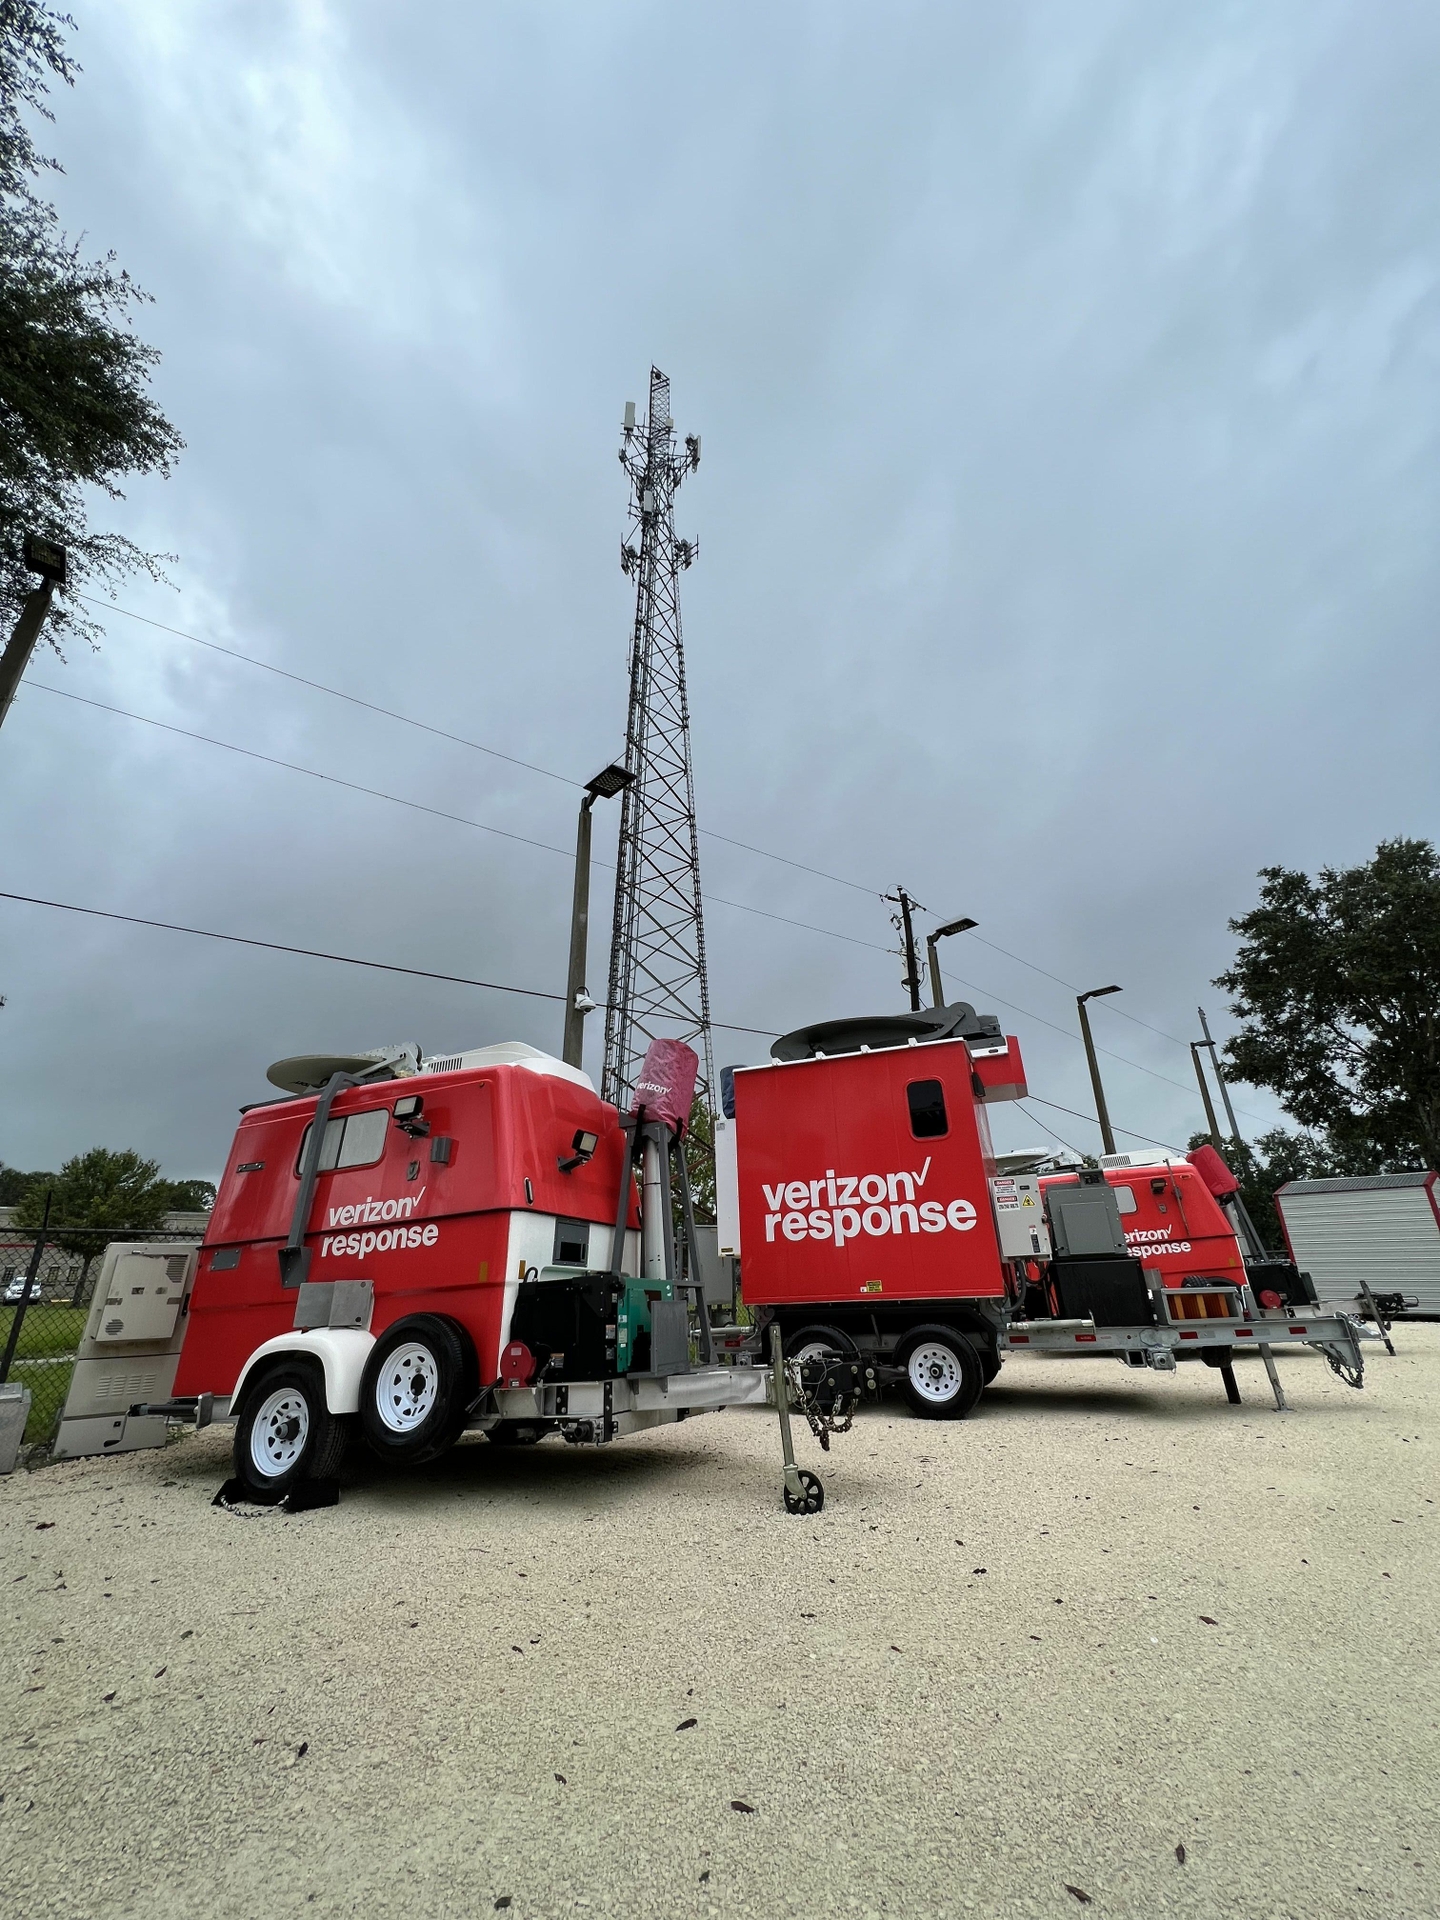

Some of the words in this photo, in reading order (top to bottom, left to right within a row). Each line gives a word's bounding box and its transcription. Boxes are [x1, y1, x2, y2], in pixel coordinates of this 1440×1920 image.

[762, 1169, 915, 1211] verizon
[329, 1196, 412, 1227] verizon
[765, 1199, 977, 1247] response
[321, 1224, 439, 1260] response
[1124, 1229, 1168, 1243] erizon
[1127, 1241, 1192, 1258] esponse
